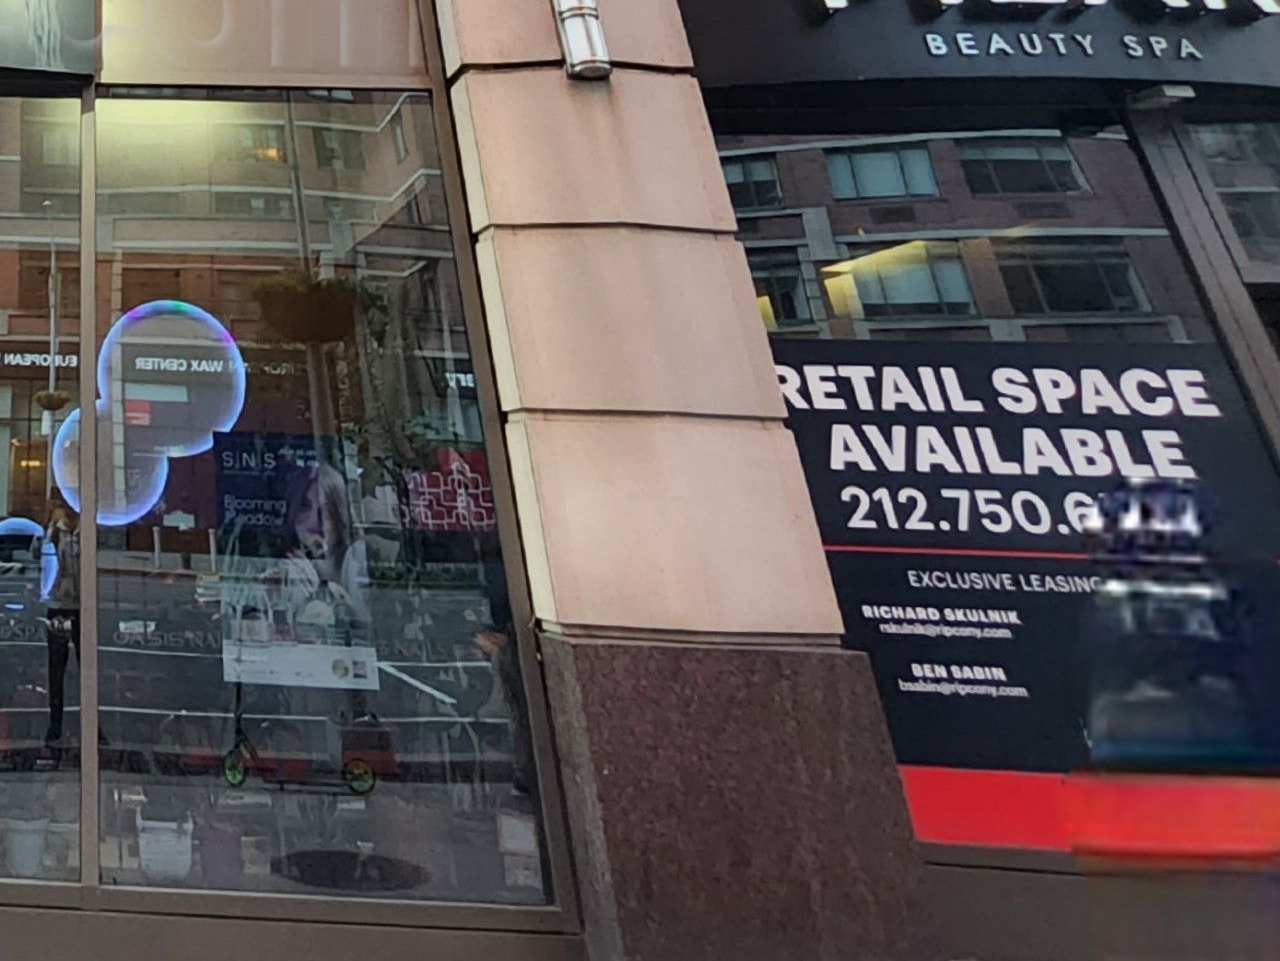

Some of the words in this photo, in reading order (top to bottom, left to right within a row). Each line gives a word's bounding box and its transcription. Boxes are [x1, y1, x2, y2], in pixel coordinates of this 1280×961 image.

[925, 32, 1095, 59] BEAUTY
[1122, 34, 1204, 61] SPA
[773, 364, 984, 413] RETAIL
[991, 367, 1222, 418] SPACE
[829, 424, 1199, 480] AVAILABLE
[907, 569, 1016, 591] EXCLUSIVE
[861, 604, 940, 622] RICHARD
[942, 606, 1023, 625] SKULNIK
[910, 662, 948, 680] BEN
[949, 664, 1008, 682] SABIN
